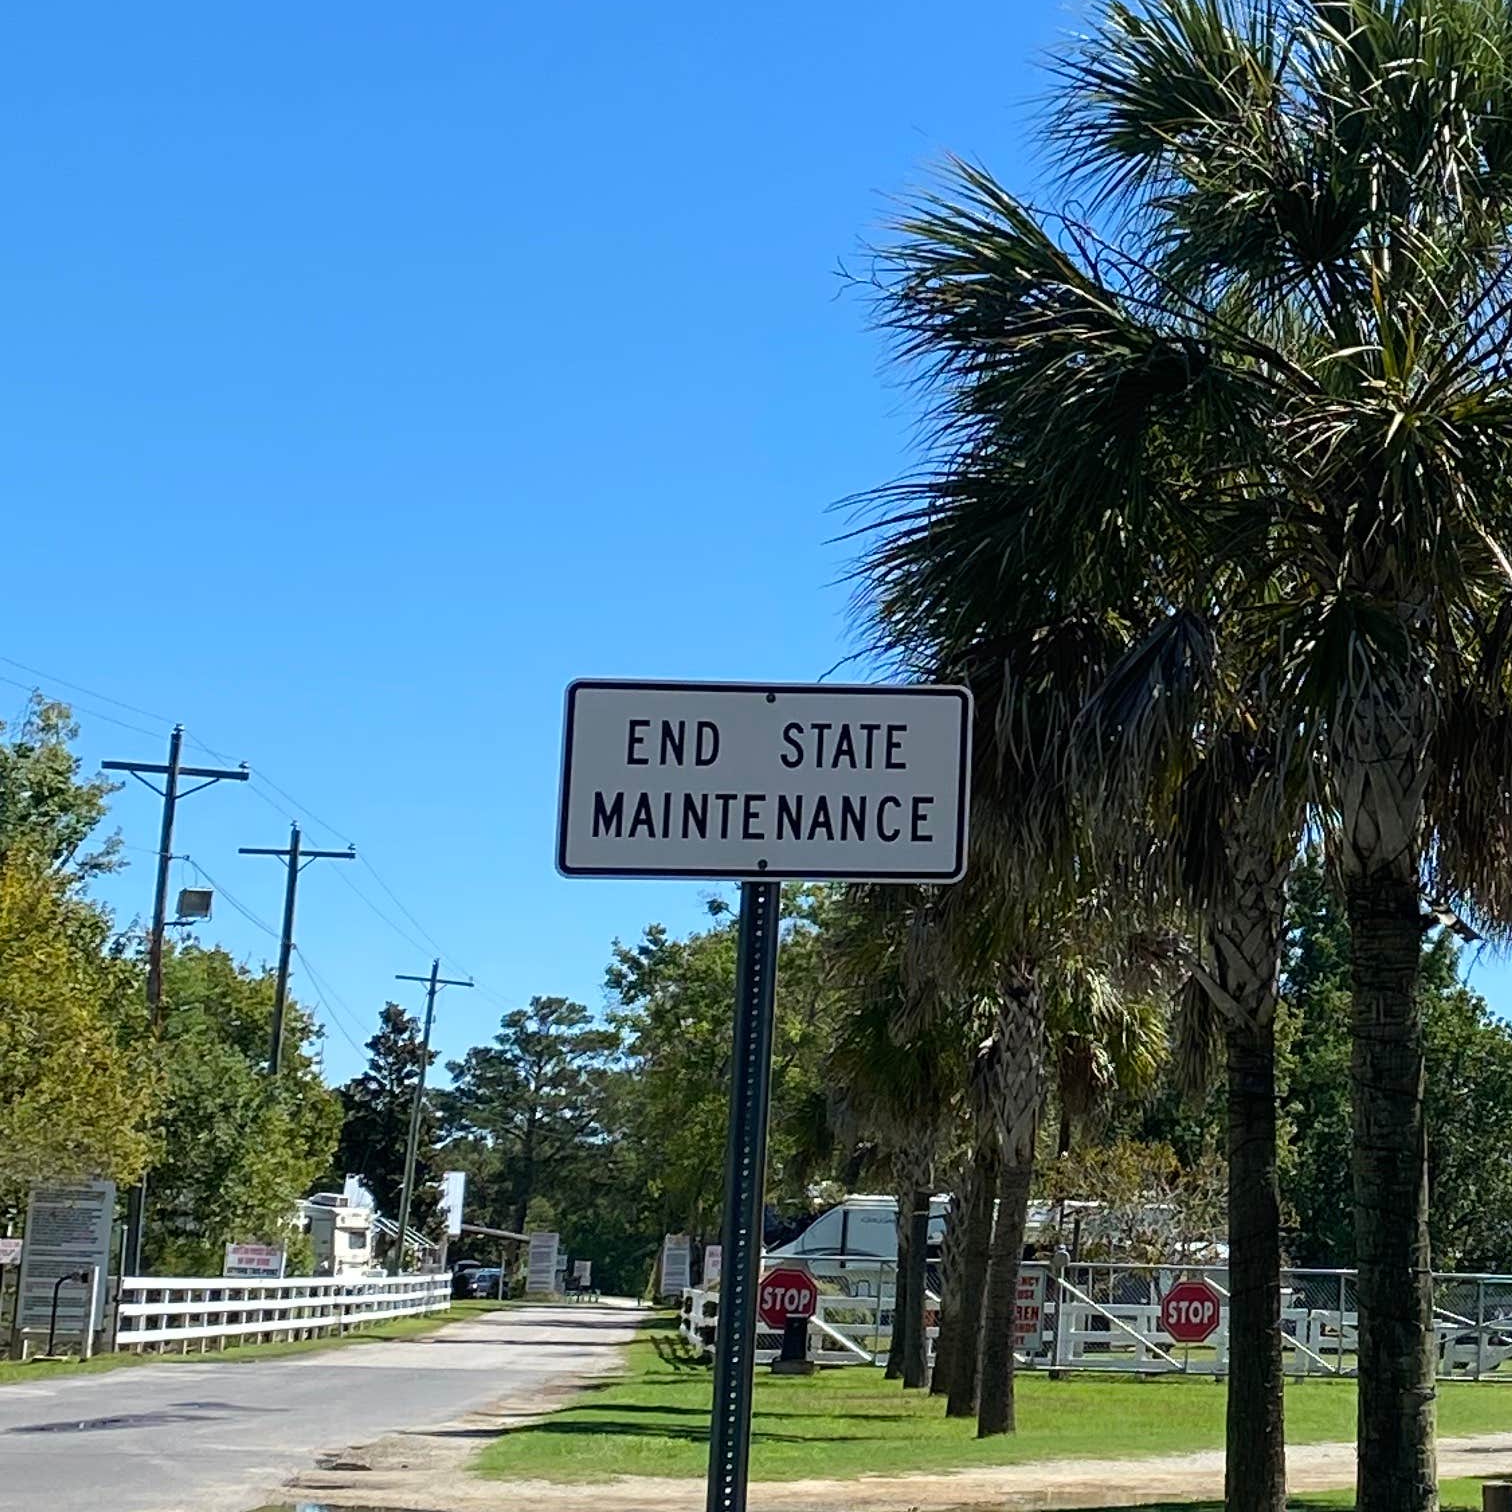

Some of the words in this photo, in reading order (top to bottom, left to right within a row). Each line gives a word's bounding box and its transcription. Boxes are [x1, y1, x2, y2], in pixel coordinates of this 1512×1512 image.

[626, 719, 720, 767] END
[780, 722, 907, 770] STATE
[592, 791, 935, 842] MAINTENANCE
[761, 1286, 810, 1311] STOP
[1168, 1301, 1214, 1324] STOP
